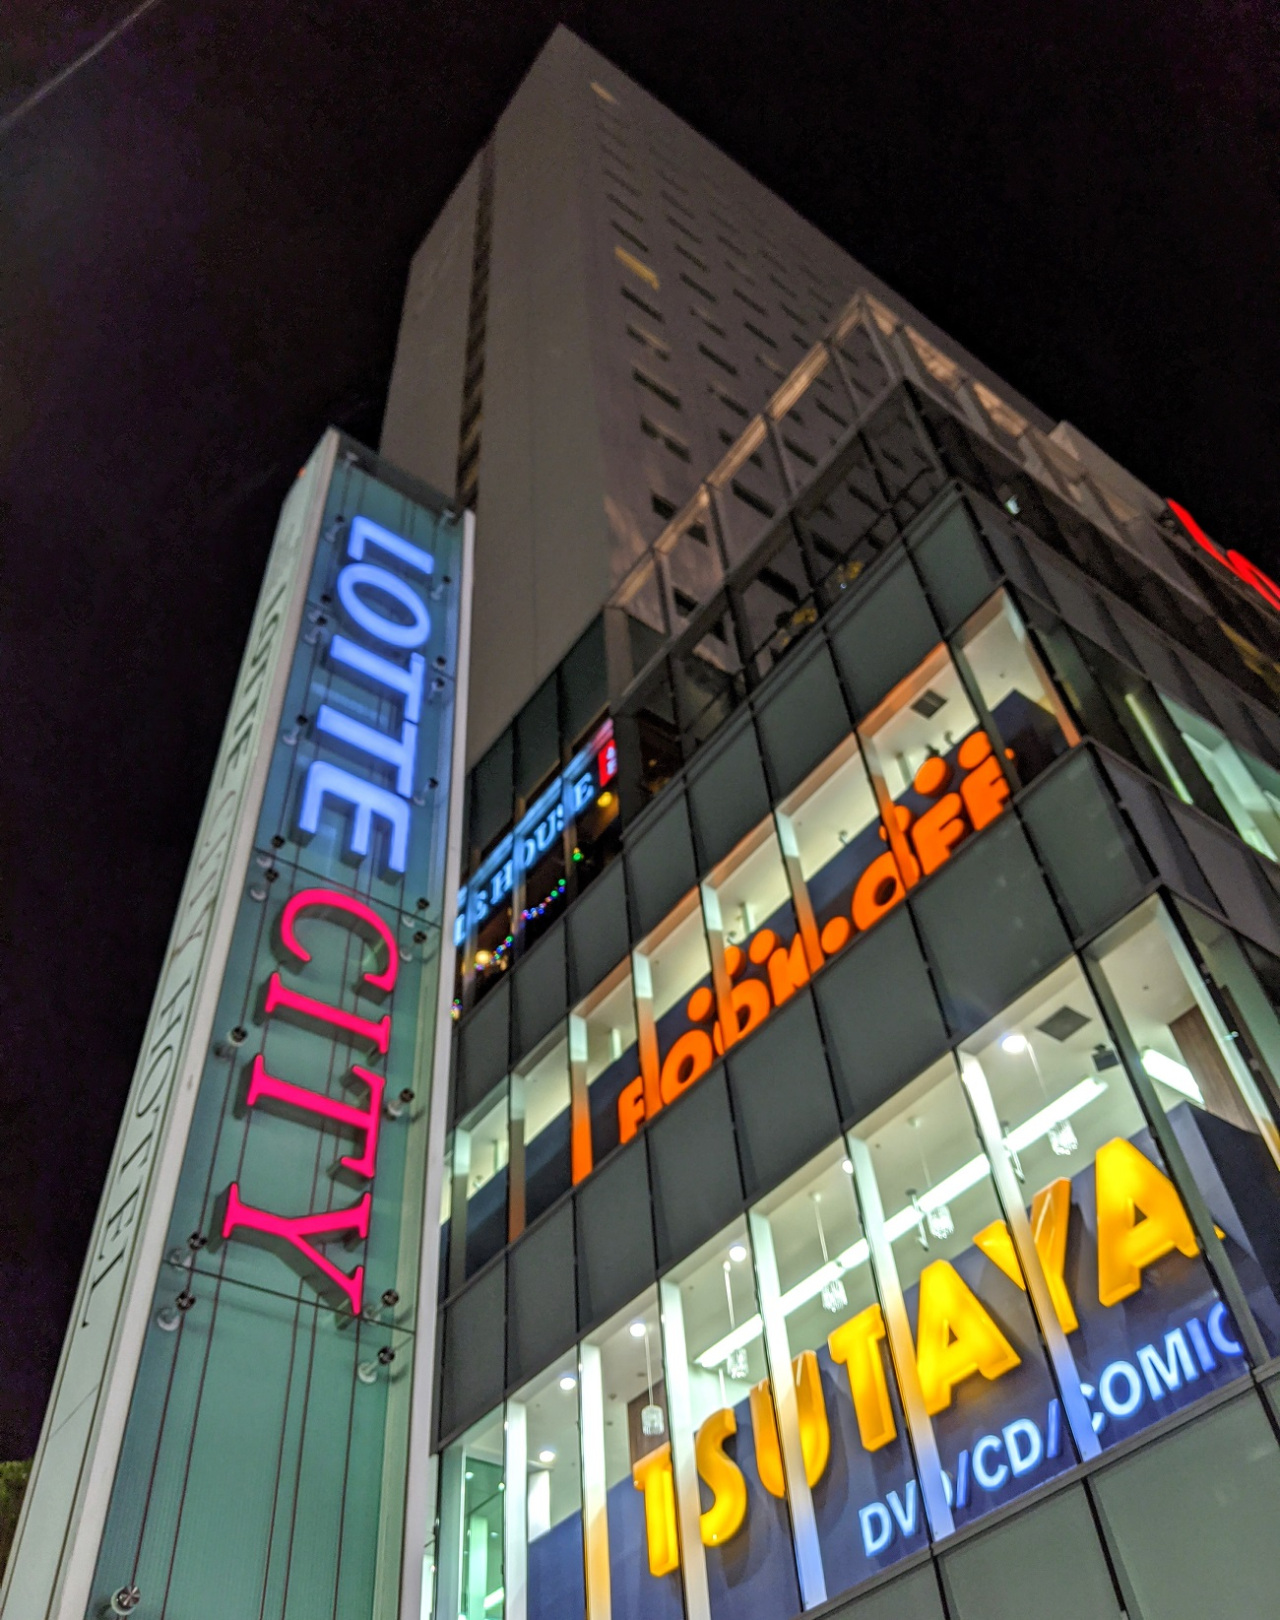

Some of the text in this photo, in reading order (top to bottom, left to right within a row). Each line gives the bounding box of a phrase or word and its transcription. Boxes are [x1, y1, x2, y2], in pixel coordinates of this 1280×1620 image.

[81, 582, 287, 1329] LOTTE CITY HOTEL
[222, 515, 434, 1316] LOTTE CITY
[632, 1136, 1225, 1577] TSUTAYA
